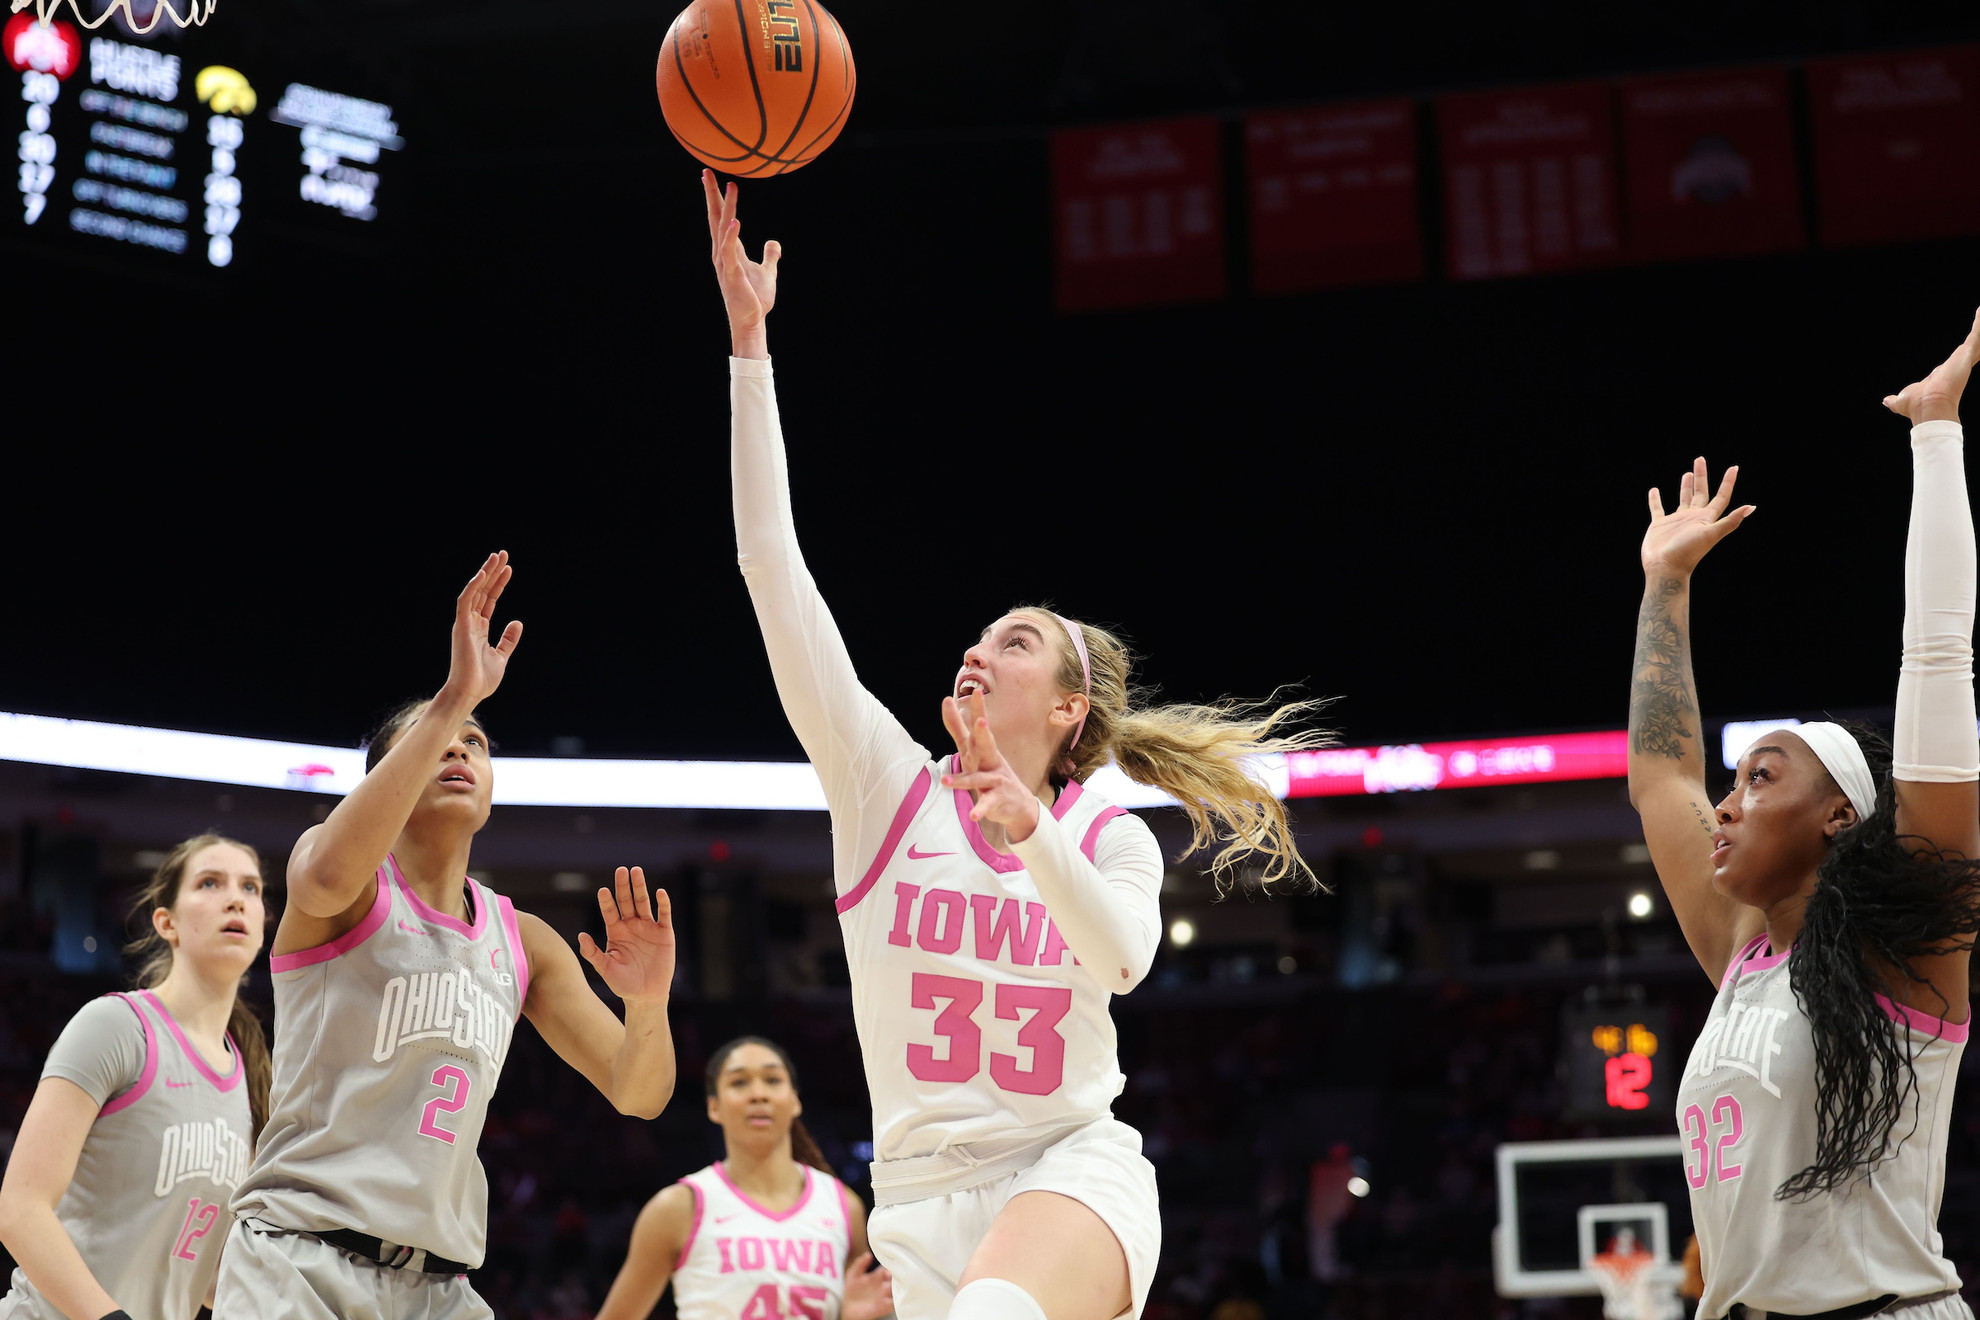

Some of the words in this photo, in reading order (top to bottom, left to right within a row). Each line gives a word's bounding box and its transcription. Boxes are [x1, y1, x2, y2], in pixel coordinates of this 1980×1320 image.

[373, 972, 457, 1063] OHIO
[906, 972, 1073, 1097] 33
[417, 1063, 472, 1146] 2
[1605, 1052, 1653, 1111] 12
[154, 1122, 215, 1198] OHIO
[211, 1117, 250, 1186] STA
[1683, 1093, 1744, 1191] 32
[171, 1197, 220, 1262] 12
[715, 1237, 839, 1280] IOWA
[740, 1283, 828, 1320] 45
